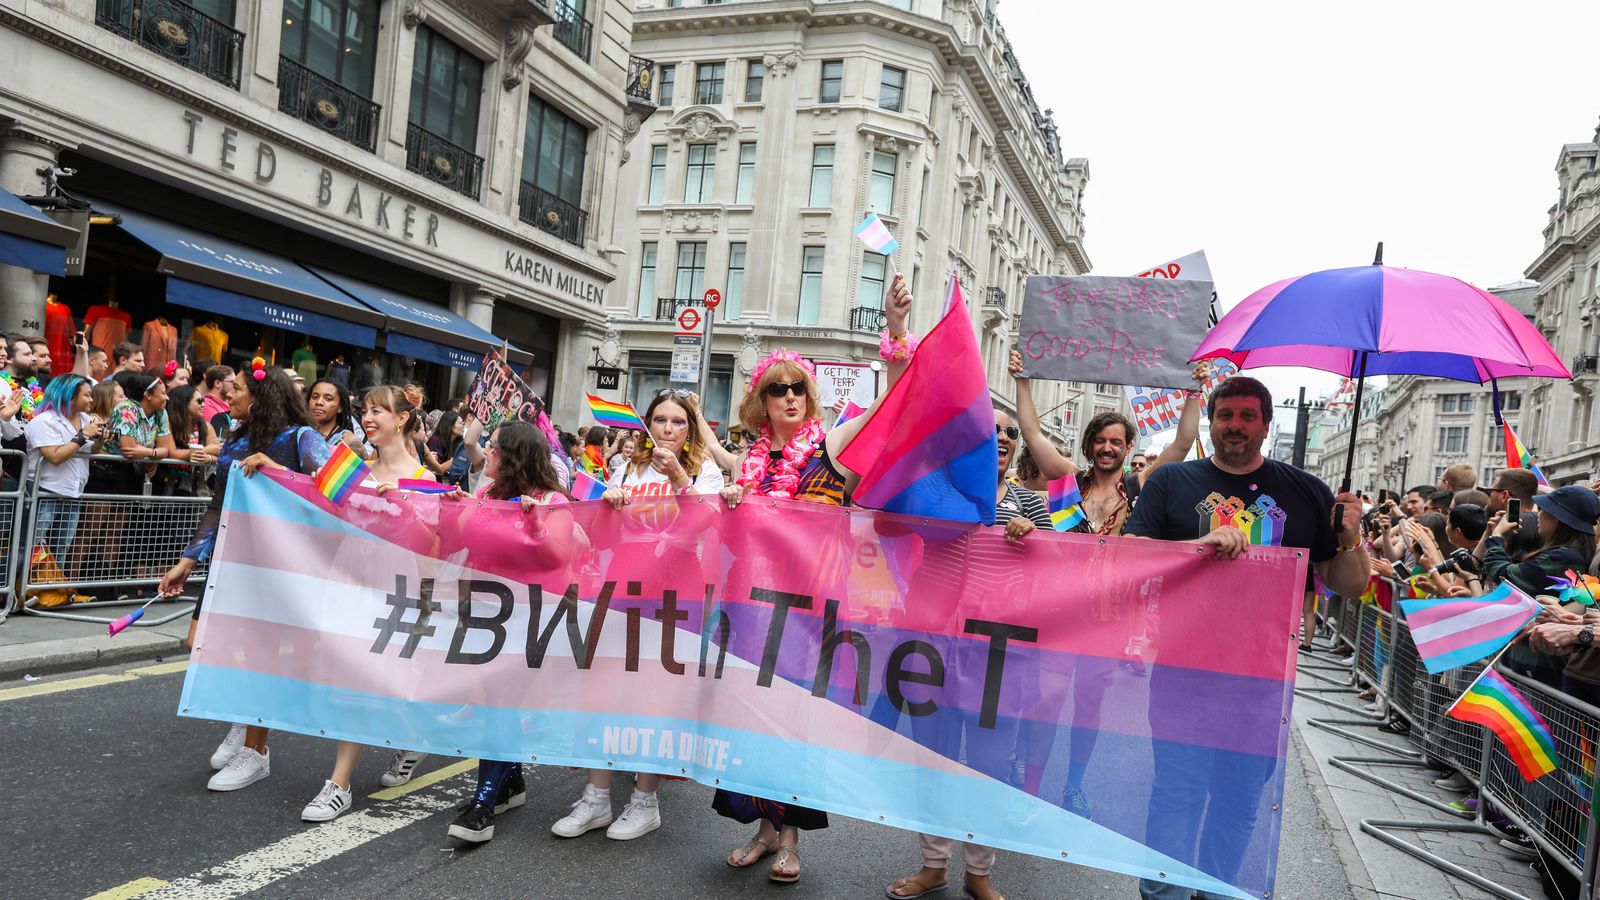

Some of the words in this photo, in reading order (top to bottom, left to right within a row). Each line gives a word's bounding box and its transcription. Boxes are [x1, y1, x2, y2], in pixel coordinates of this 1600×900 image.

[184, 110, 277, 184] TED
[317, 167, 439, 248] BAKER
[505, 250, 553, 286] KAREN
[556, 272, 604, 305] MILLEN
[706, 293, 718, 302] RC
[264, 306, 278, 316] TED
[281, 311, 303, 322] BAKER
[22, 319, 40, 330] 245
[1026, 329, 1090, 360] GOOD
[600, 375, 615, 386] KM
[823, 367, 843, 377] GET
[846, 367, 861, 378] THE
[834, 388, 851, 397] OUT
[369, 573, 1039, 731] #BWithTheT
[602, 725, 655, 757] NOT
[657, 729, 674, 760] A
